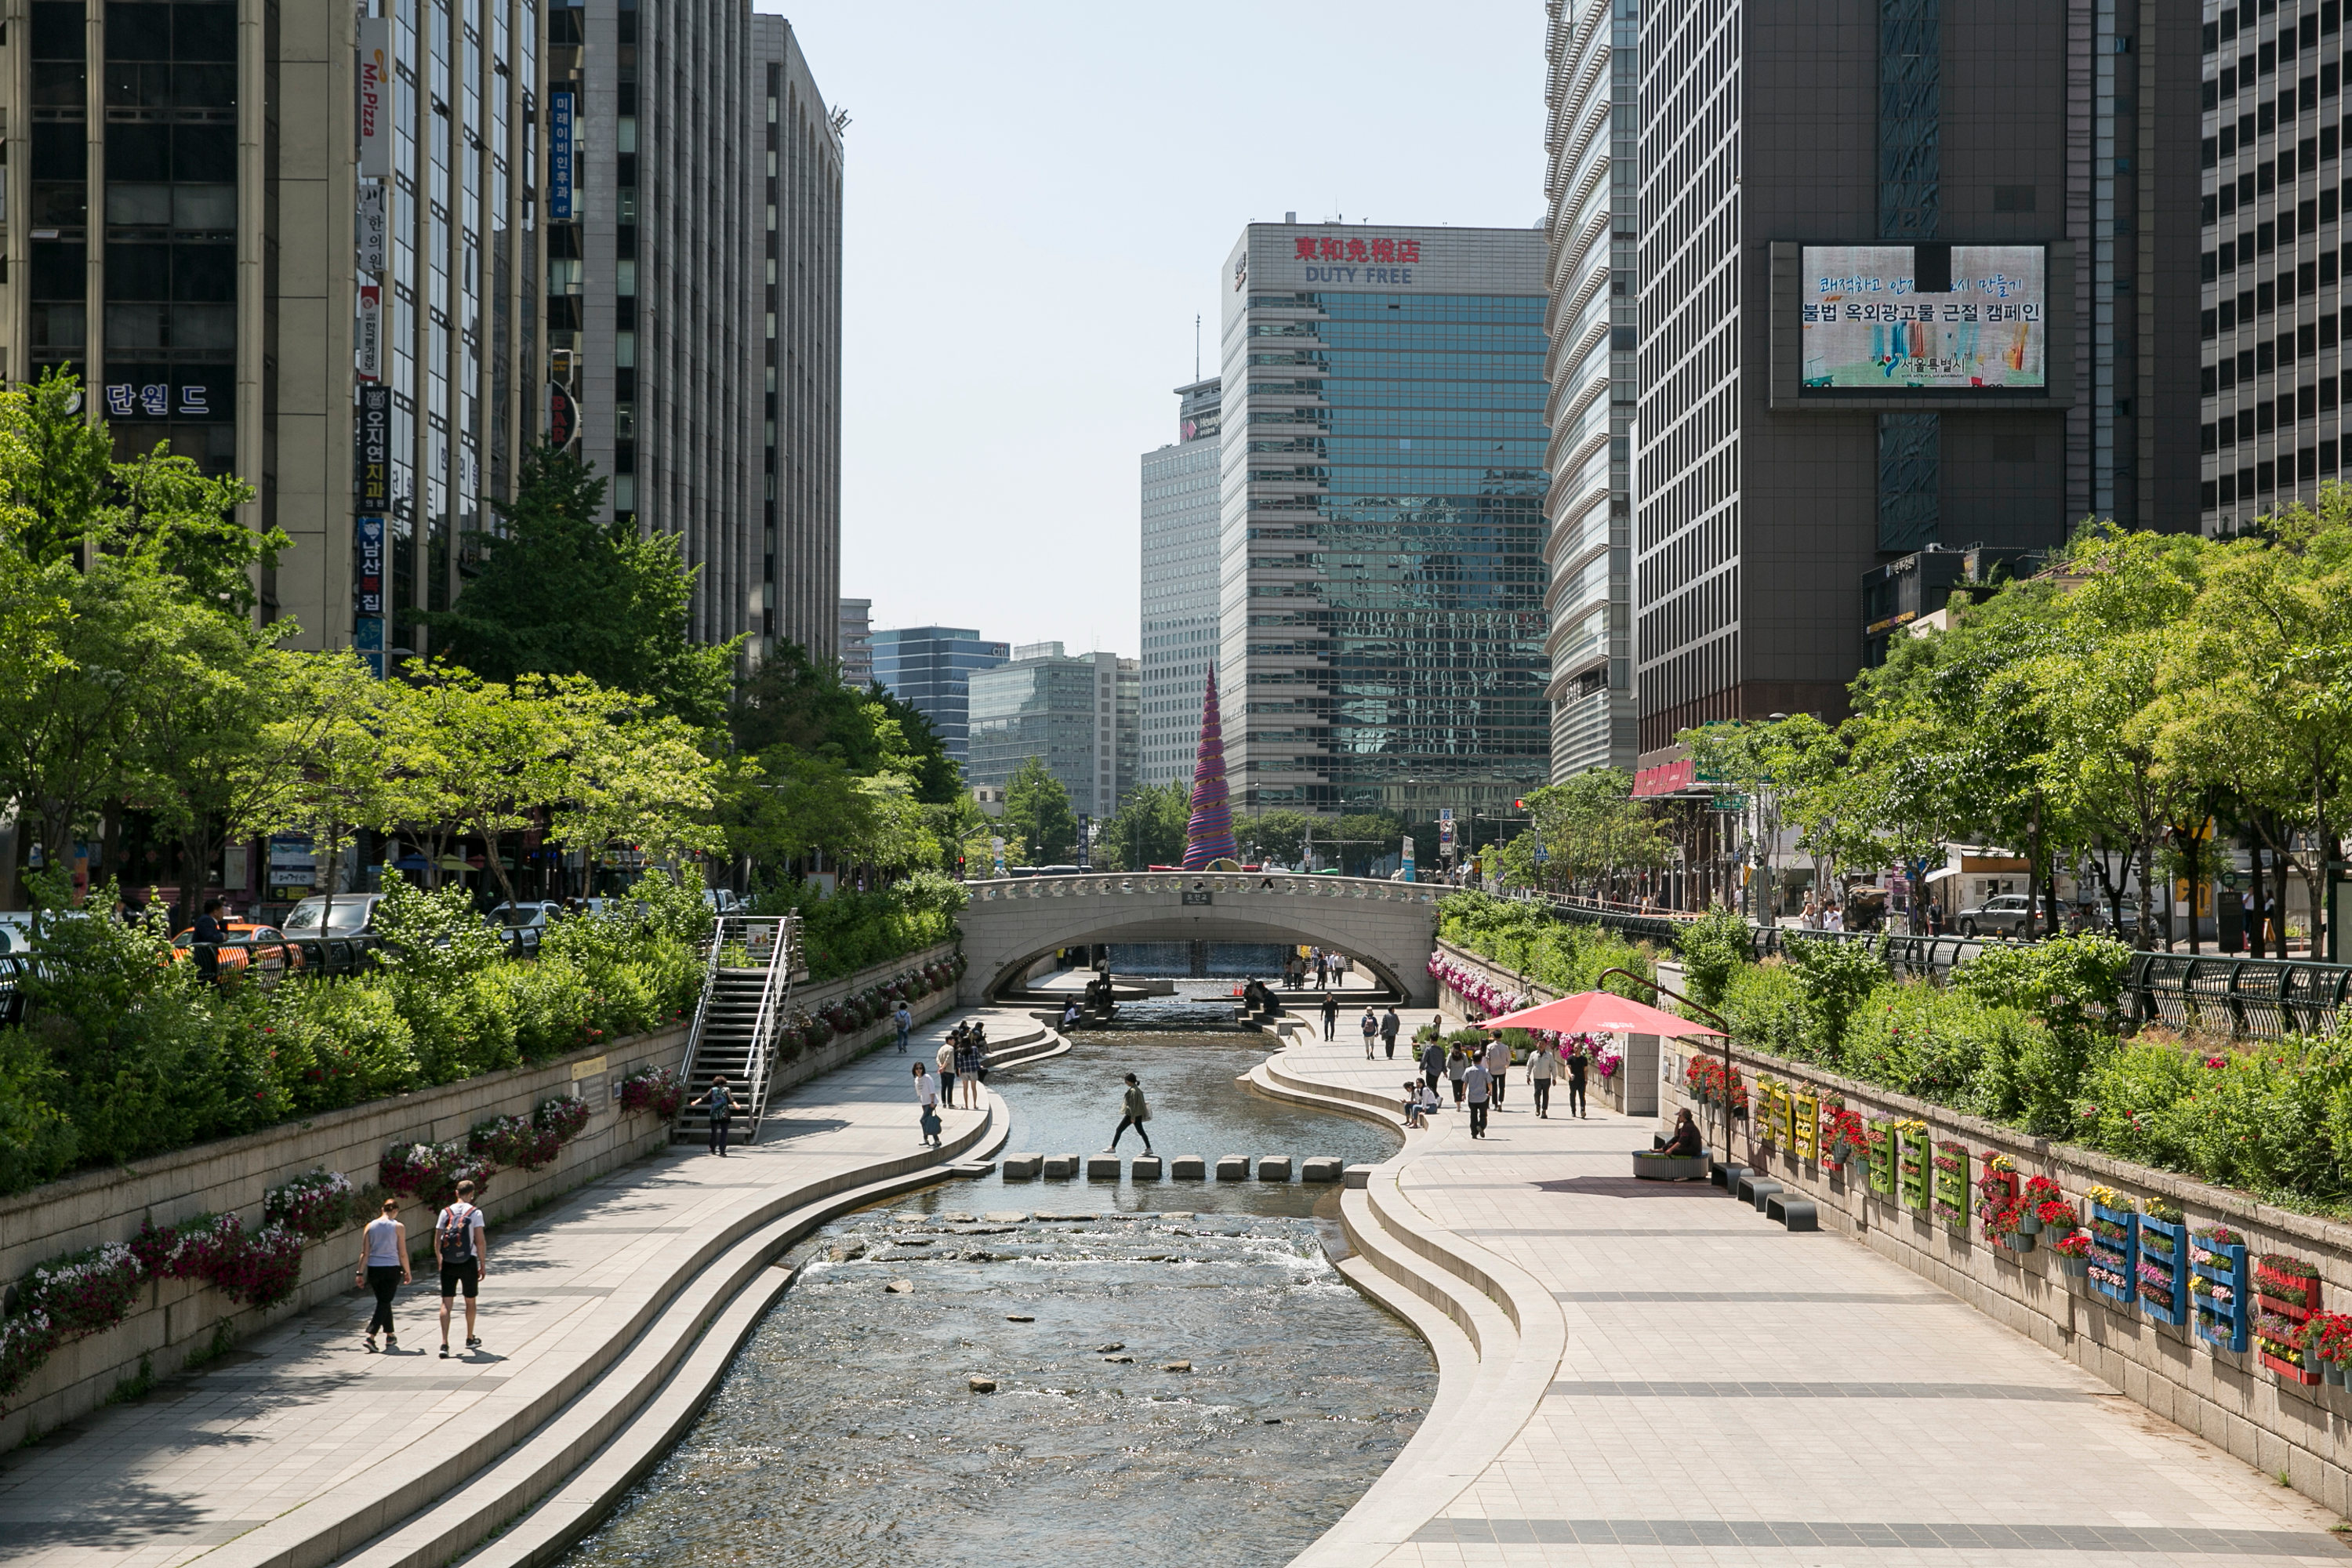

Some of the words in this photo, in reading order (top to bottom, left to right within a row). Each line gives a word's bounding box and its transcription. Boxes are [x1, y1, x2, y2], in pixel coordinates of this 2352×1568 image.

[362, 63, 379, 137] Mr.Pizza
[556, 97, 568, 198] 미래이비인후과
[557, 205, 568, 214] 4F
[368, 215, 384, 270] 한의원
[1305, 266, 1358, 283] DUTY
[1366, 267, 1413, 284] FREE
[1978, 274, 2022, 298] 만들기
[1803, 303, 1837, 322] 불법
[1845, 303, 1935, 322] 옥외광고물
[1942, 303, 1979, 322] 근절
[1986, 303, 2039, 322] 캠페인
[1900, 358, 1965, 373] 서울특별시
[106, 383, 210, 416] 단월드
[551, 396, 567, 442] BAR
